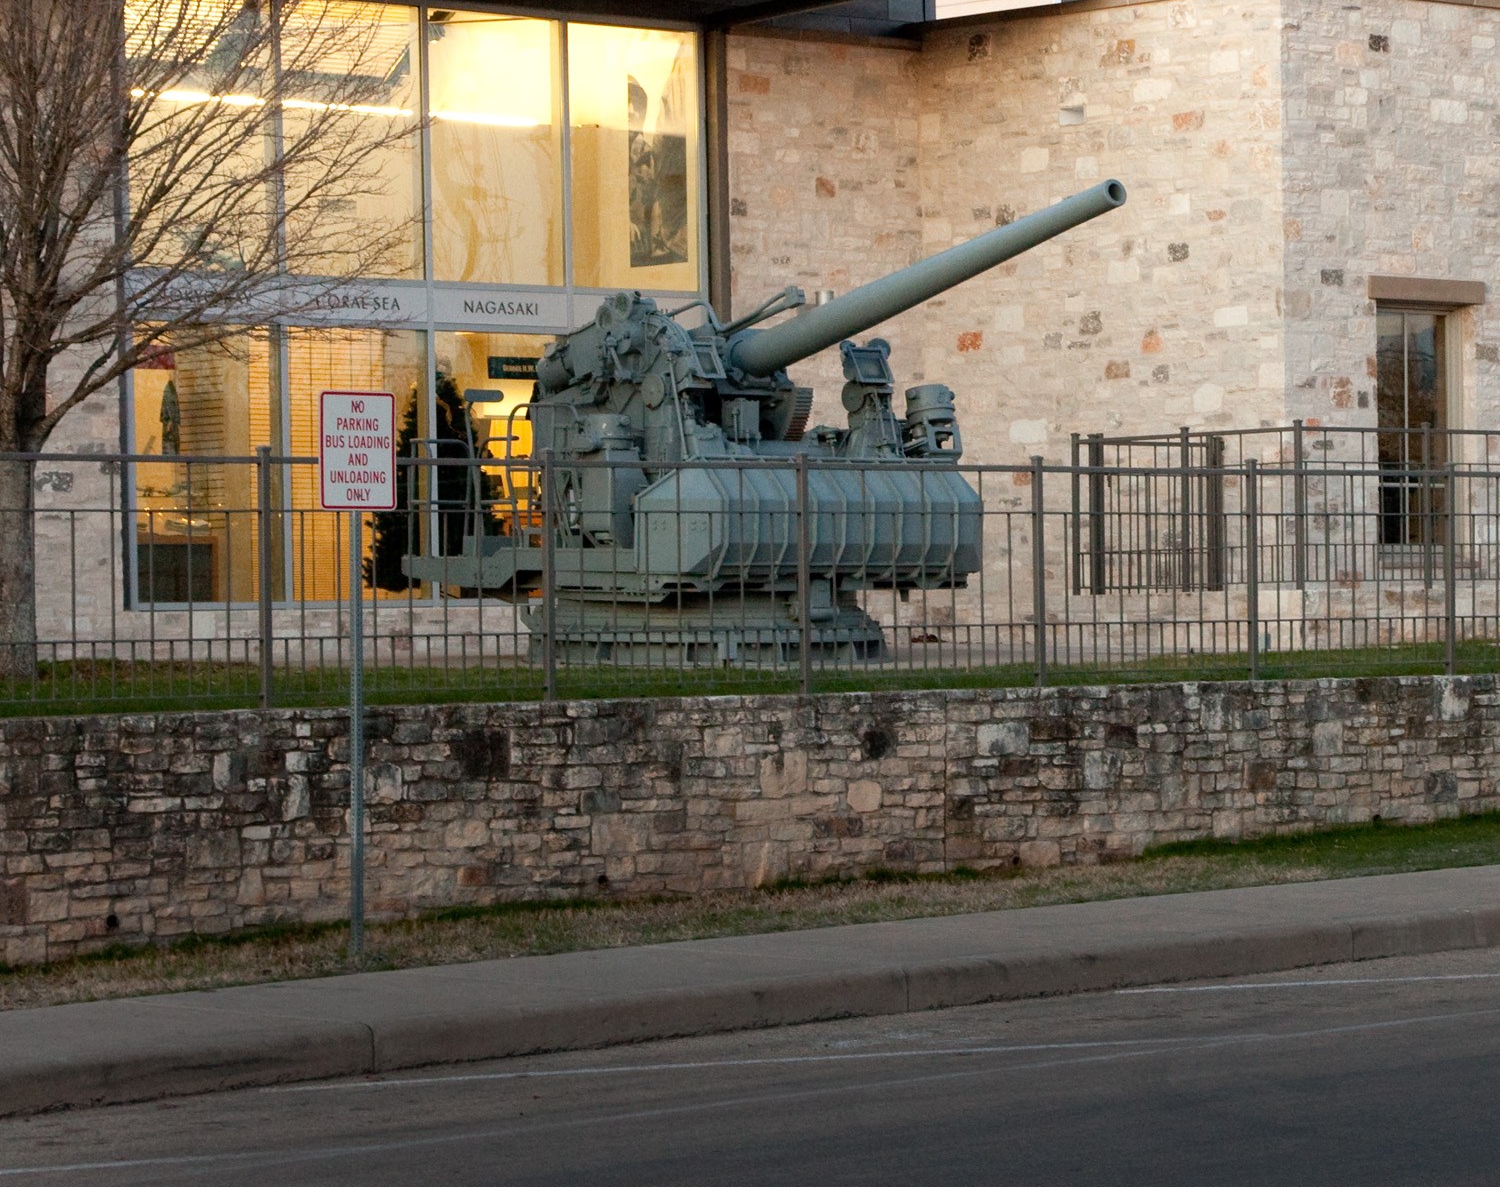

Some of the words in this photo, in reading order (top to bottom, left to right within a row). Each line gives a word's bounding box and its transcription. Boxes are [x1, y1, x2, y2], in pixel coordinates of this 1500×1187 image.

[373, 296, 400, 311] SEA
[464, 299, 539, 316] NAGASAKI
[351, 400, 365, 413] NO
[336, 417, 379, 431] PARKING
[325, 435, 345, 448] BUS
[348, 435, 390, 449] LOADING
[347, 453, 369, 466] AND
[330, 470, 386, 484] UNLOADING
[346, 488, 371, 501] ONLY
